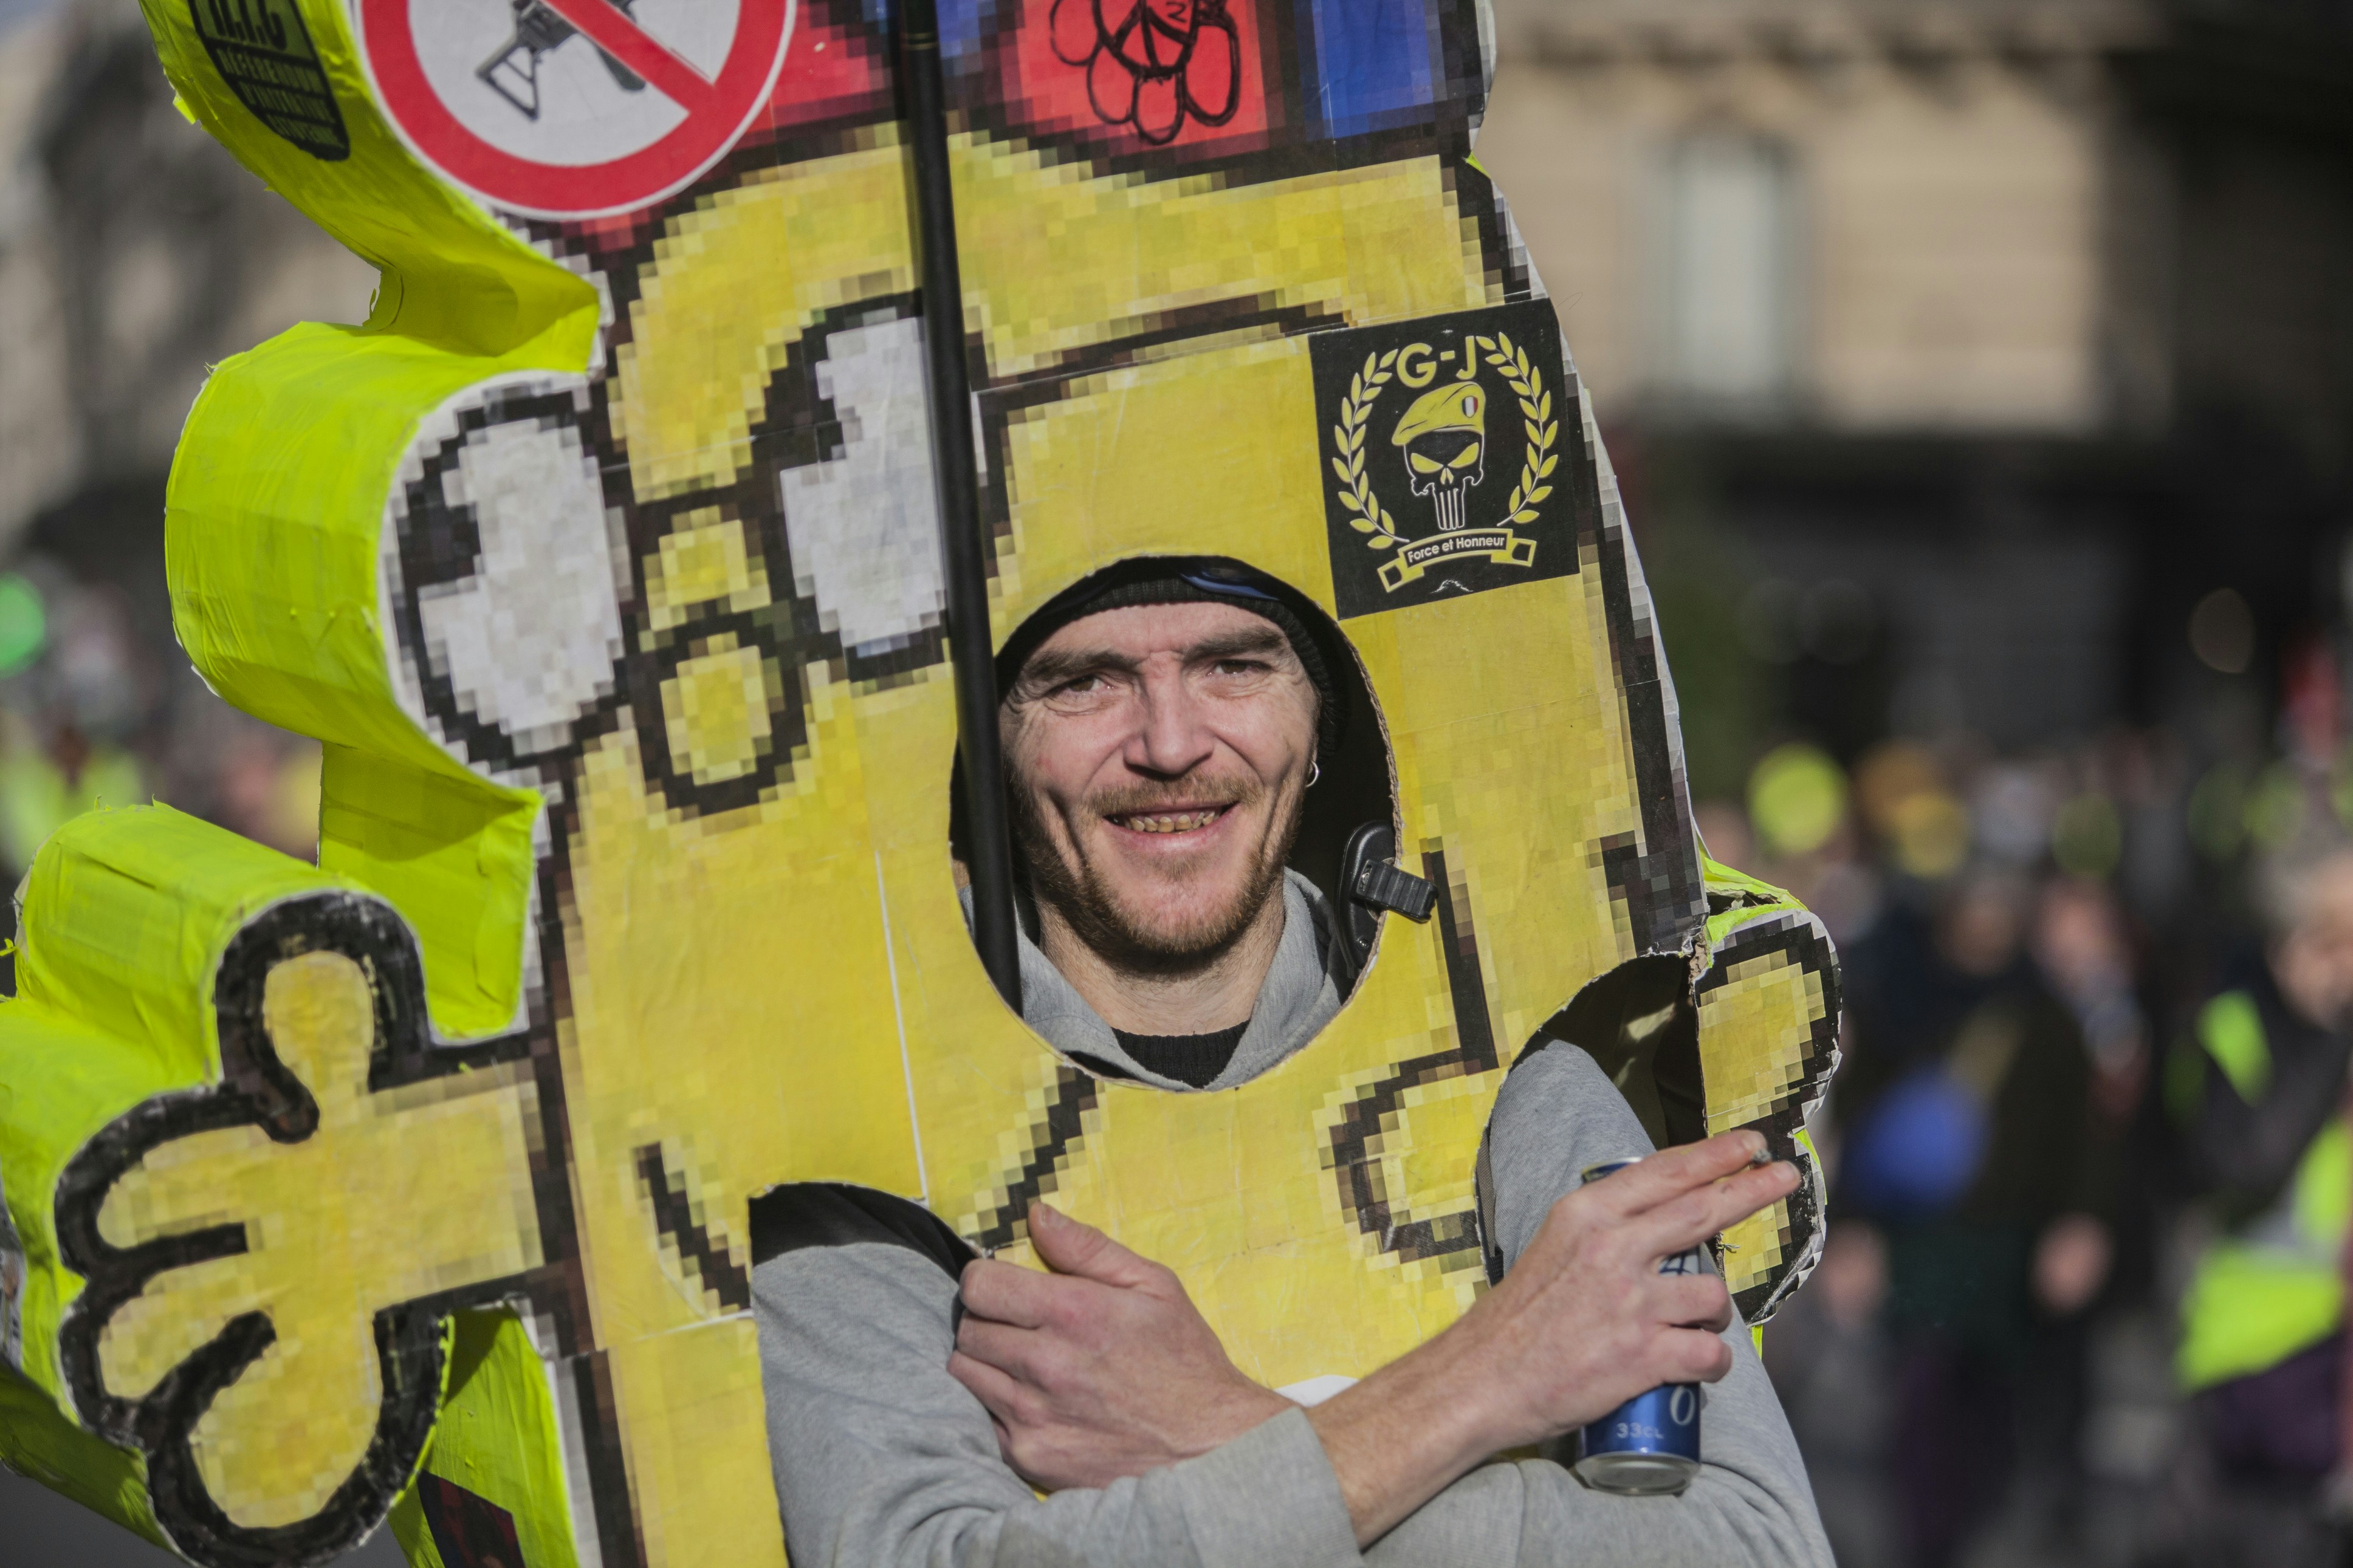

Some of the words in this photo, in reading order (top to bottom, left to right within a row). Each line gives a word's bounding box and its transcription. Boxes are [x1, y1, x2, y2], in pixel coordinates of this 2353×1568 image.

[1396, 335, 1477, 389] G-J
[1407, 545, 1440, 563] Force
[1441, 538, 1454, 552] et
[1455, 536, 1505, 549] Honneur
